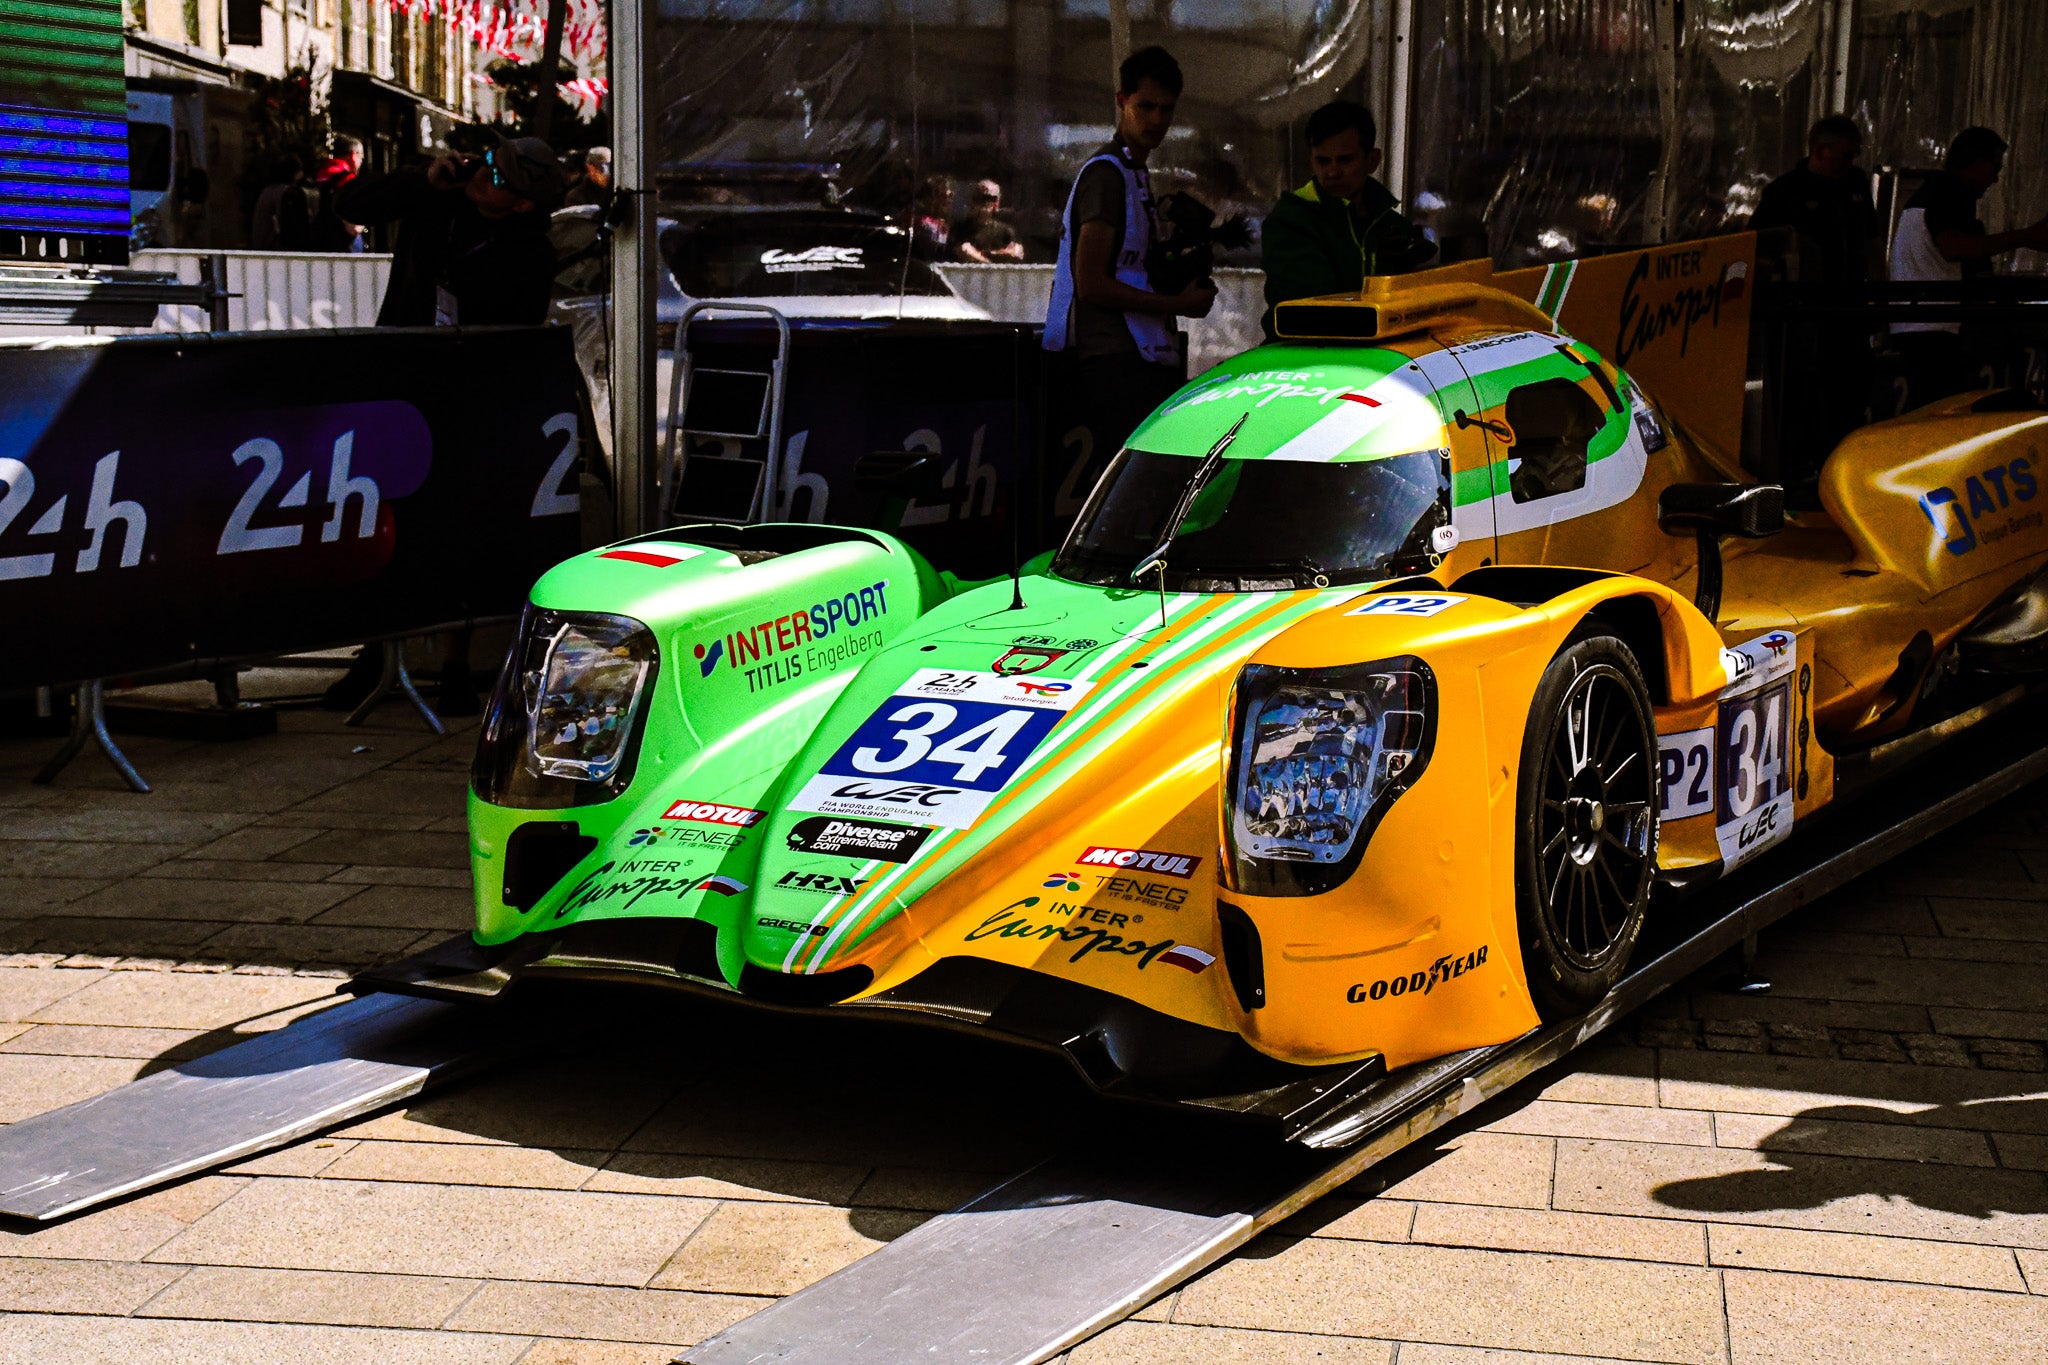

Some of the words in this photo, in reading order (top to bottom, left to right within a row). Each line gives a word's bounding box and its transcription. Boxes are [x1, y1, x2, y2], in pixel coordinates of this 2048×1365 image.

[1656, 251, 1700, 280] INTER
[1236, 371, 1311, 382] INTER
[216, 429, 381, 555] 24h
[1965, 458, 2037, 520] ATS
[0, 449, 148, 581] 24h
[1357, 598, 1448, 613] P2
[726, 580, 889, 669] INTERSPORT
[744, 653, 802, 694] TITLIS
[851, 702, 1035, 783] 34
[1728, 695, 1781, 818] 34
[1660, 744, 1709, 811] P2
[830, 782, 963, 807] WEC
[666, 802, 759, 825] MOTUL
[818, 806, 890, 818] CHAMPIONSHIP
[840, 802, 874, 811] WORLD
[874, 805, 935, 818] ENDURANCE
[670, 827, 746, 847] TENEG
[1738, 802, 1779, 850] WEC
[810, 842, 841, 851] .com
[816, 834, 898, 851] ExtremeTeam
[618, 860, 681, 873] INTER
[1082, 848, 1197, 876] MOTUL
[776, 871, 869, 894] HRX
[1095, 875, 1189, 904] TENEG
[1121, 893, 1133, 901] IS
[1134, 896, 1181, 912] FASTER
[757, 917, 813, 934] ORECA
